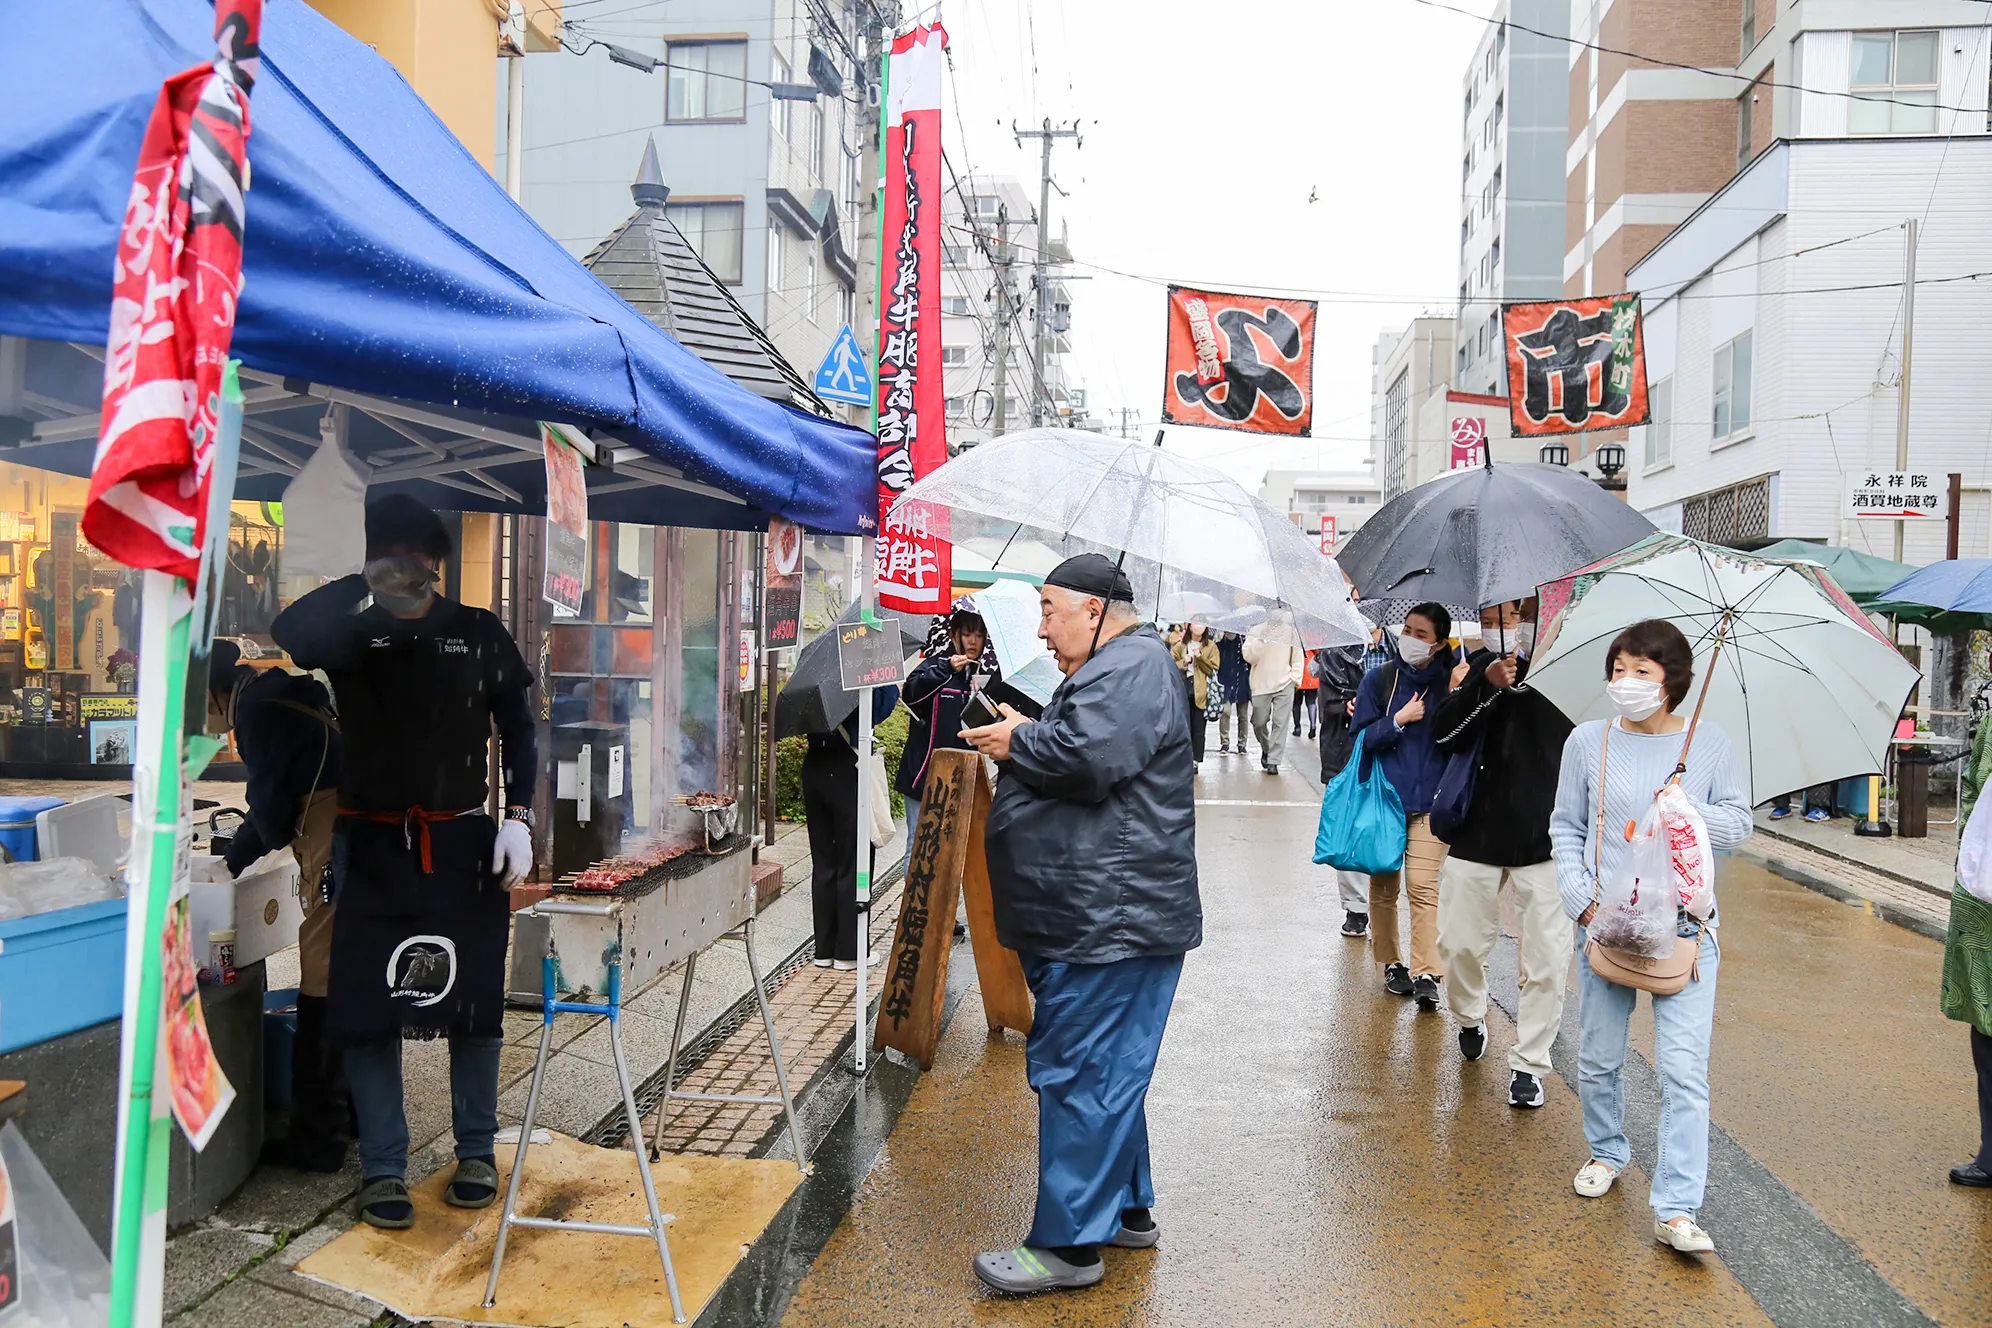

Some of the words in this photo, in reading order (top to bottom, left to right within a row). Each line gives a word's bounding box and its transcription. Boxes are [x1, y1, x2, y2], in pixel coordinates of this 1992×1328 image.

[1174, 305, 1306, 424] よ
[1513, 306, 1631, 427] 市
[1610, 306, 1637, 389] 材木町
[1852, 494, 1938, 508] 酒買地蔵尊
[1864, 474, 1928, 488] 永祥院
[886, 776, 949, 1032] 山形村短角牛
